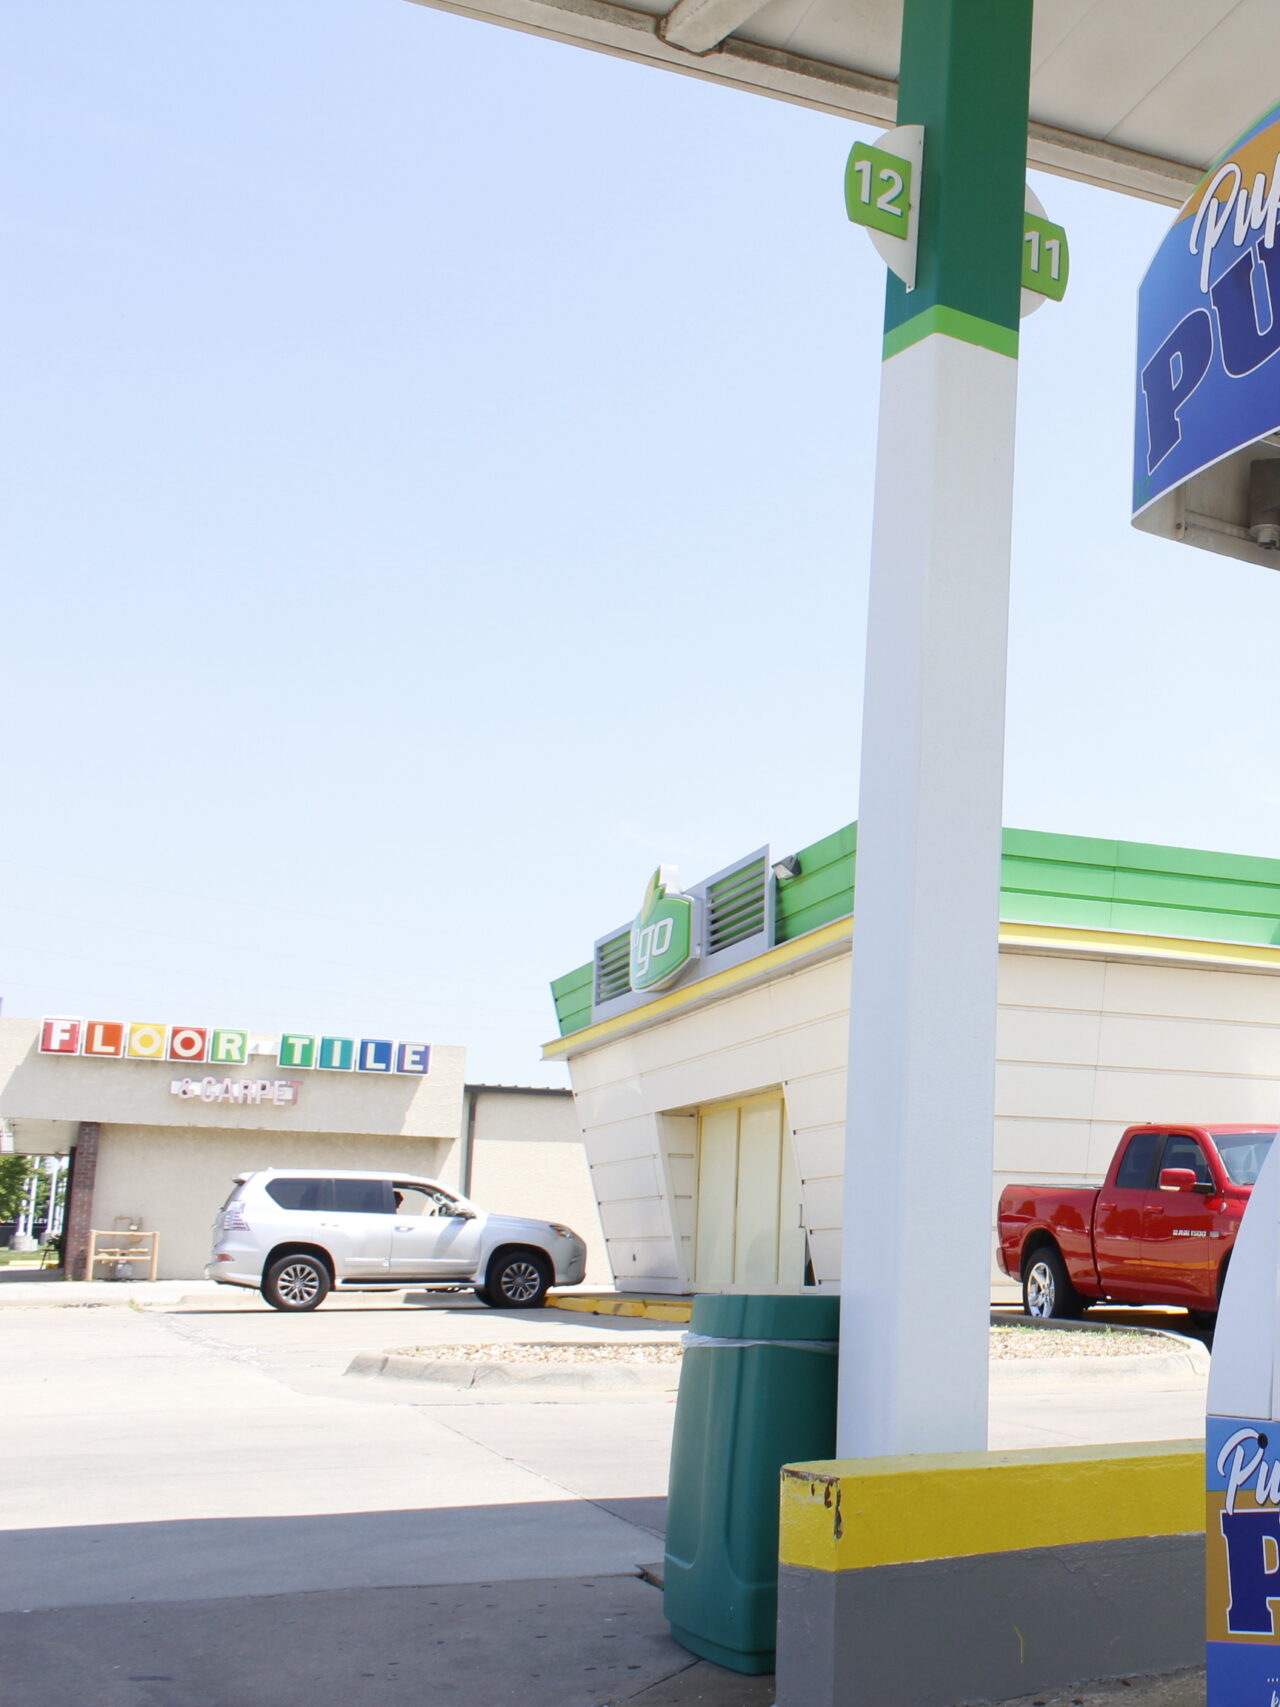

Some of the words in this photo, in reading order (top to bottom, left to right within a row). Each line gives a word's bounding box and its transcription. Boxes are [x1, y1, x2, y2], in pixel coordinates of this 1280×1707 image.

[854, 159, 904, 217] 12
[1024, 230, 1060, 281] 11
[47, 1020, 244, 1062] FLOOR
[286, 1036, 427, 1072] TILE
[201, 1076, 304, 1106] CARPET
